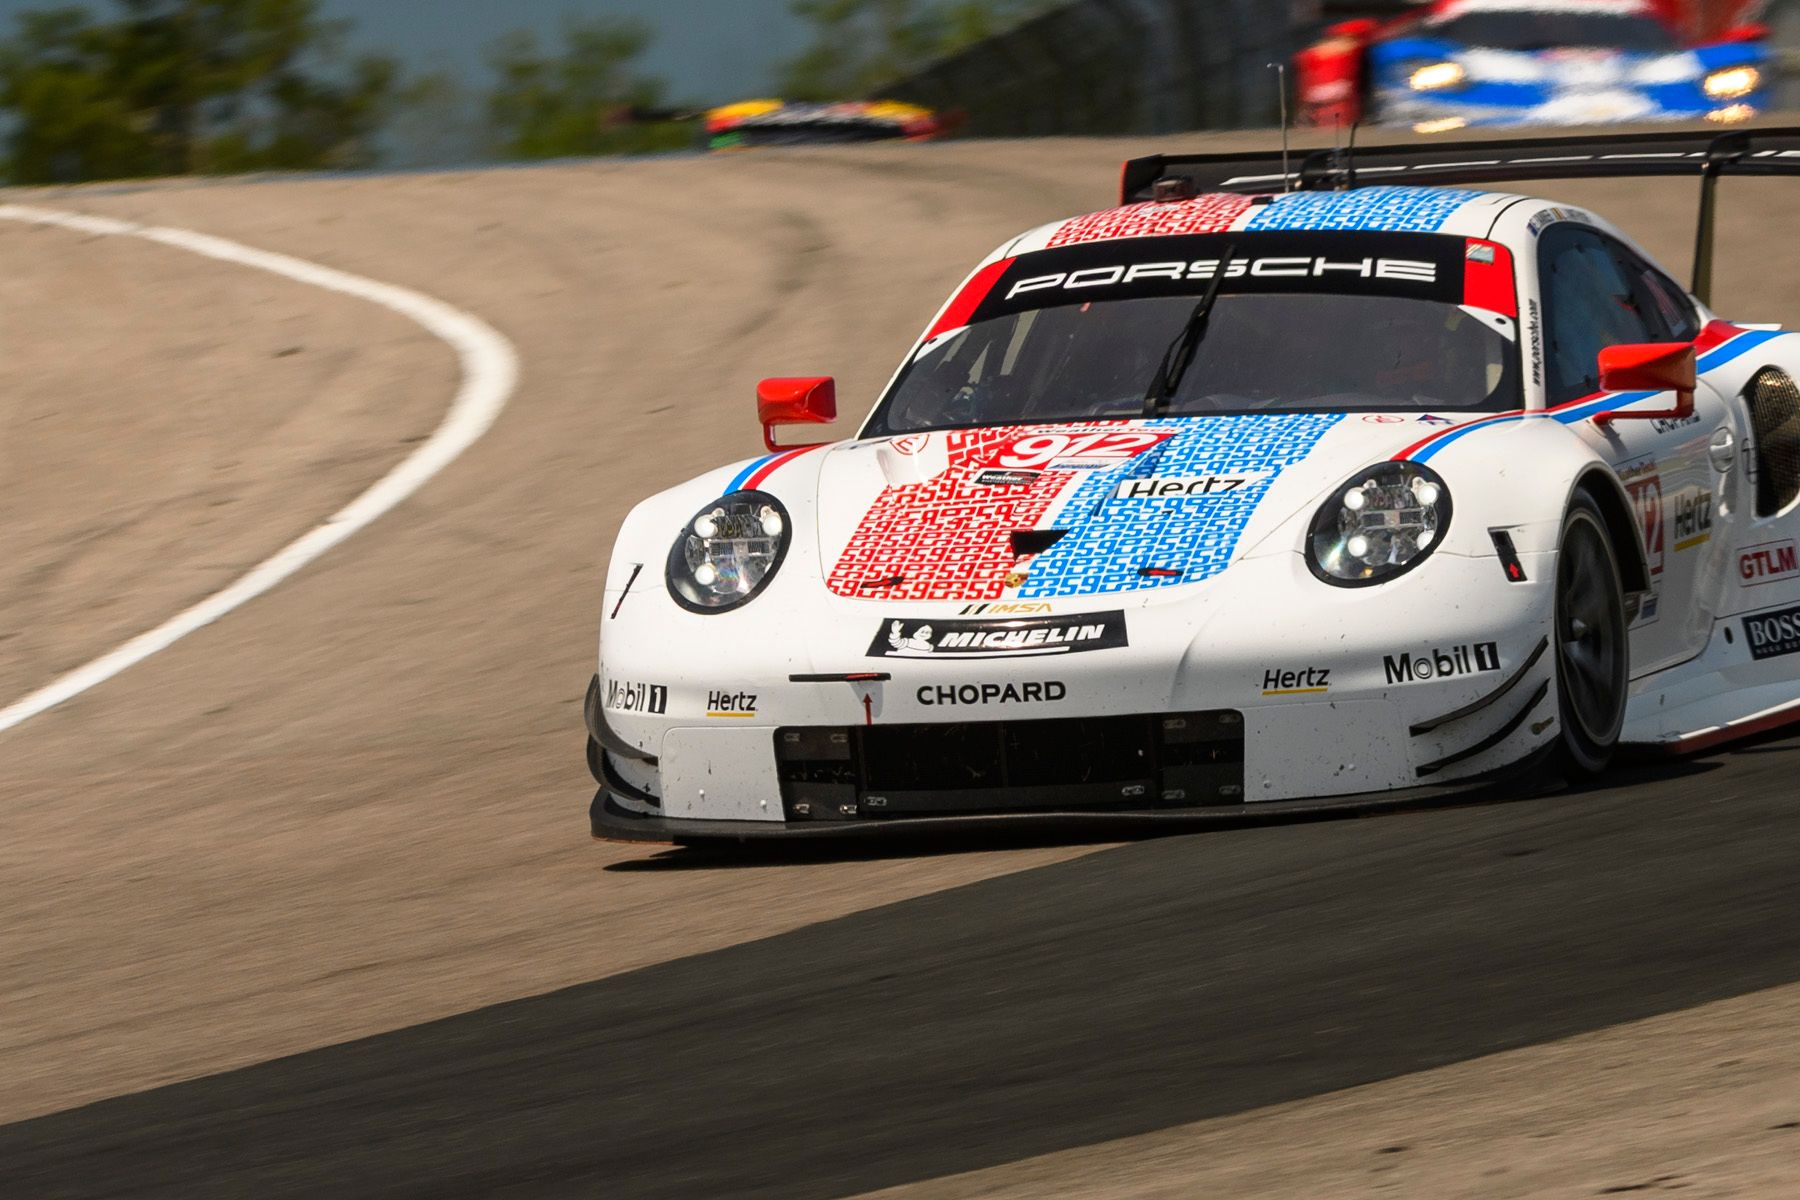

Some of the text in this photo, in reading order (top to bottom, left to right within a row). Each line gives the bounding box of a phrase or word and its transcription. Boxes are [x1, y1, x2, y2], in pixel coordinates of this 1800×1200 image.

[1005, 256, 1437, 300] PORSCHE
[999, 433, 1158, 468] 912
[1129, 476, 1247, 499] Hertz
[1674, 493, 1712, 540] Hertz
[1738, 546, 1799, 580] GTLM
[989, 603, 1053, 615] IMSA
[938, 624, 1105, 649] MICHELIN
[1262, 666, 1331, 690] Hertz
[1383, 645, 1472, 685] Mobil
[606, 679, 646, 712] Mobil
[707, 690, 758, 711] Hertz
[916, 681, 1067, 705] CHOPARD
